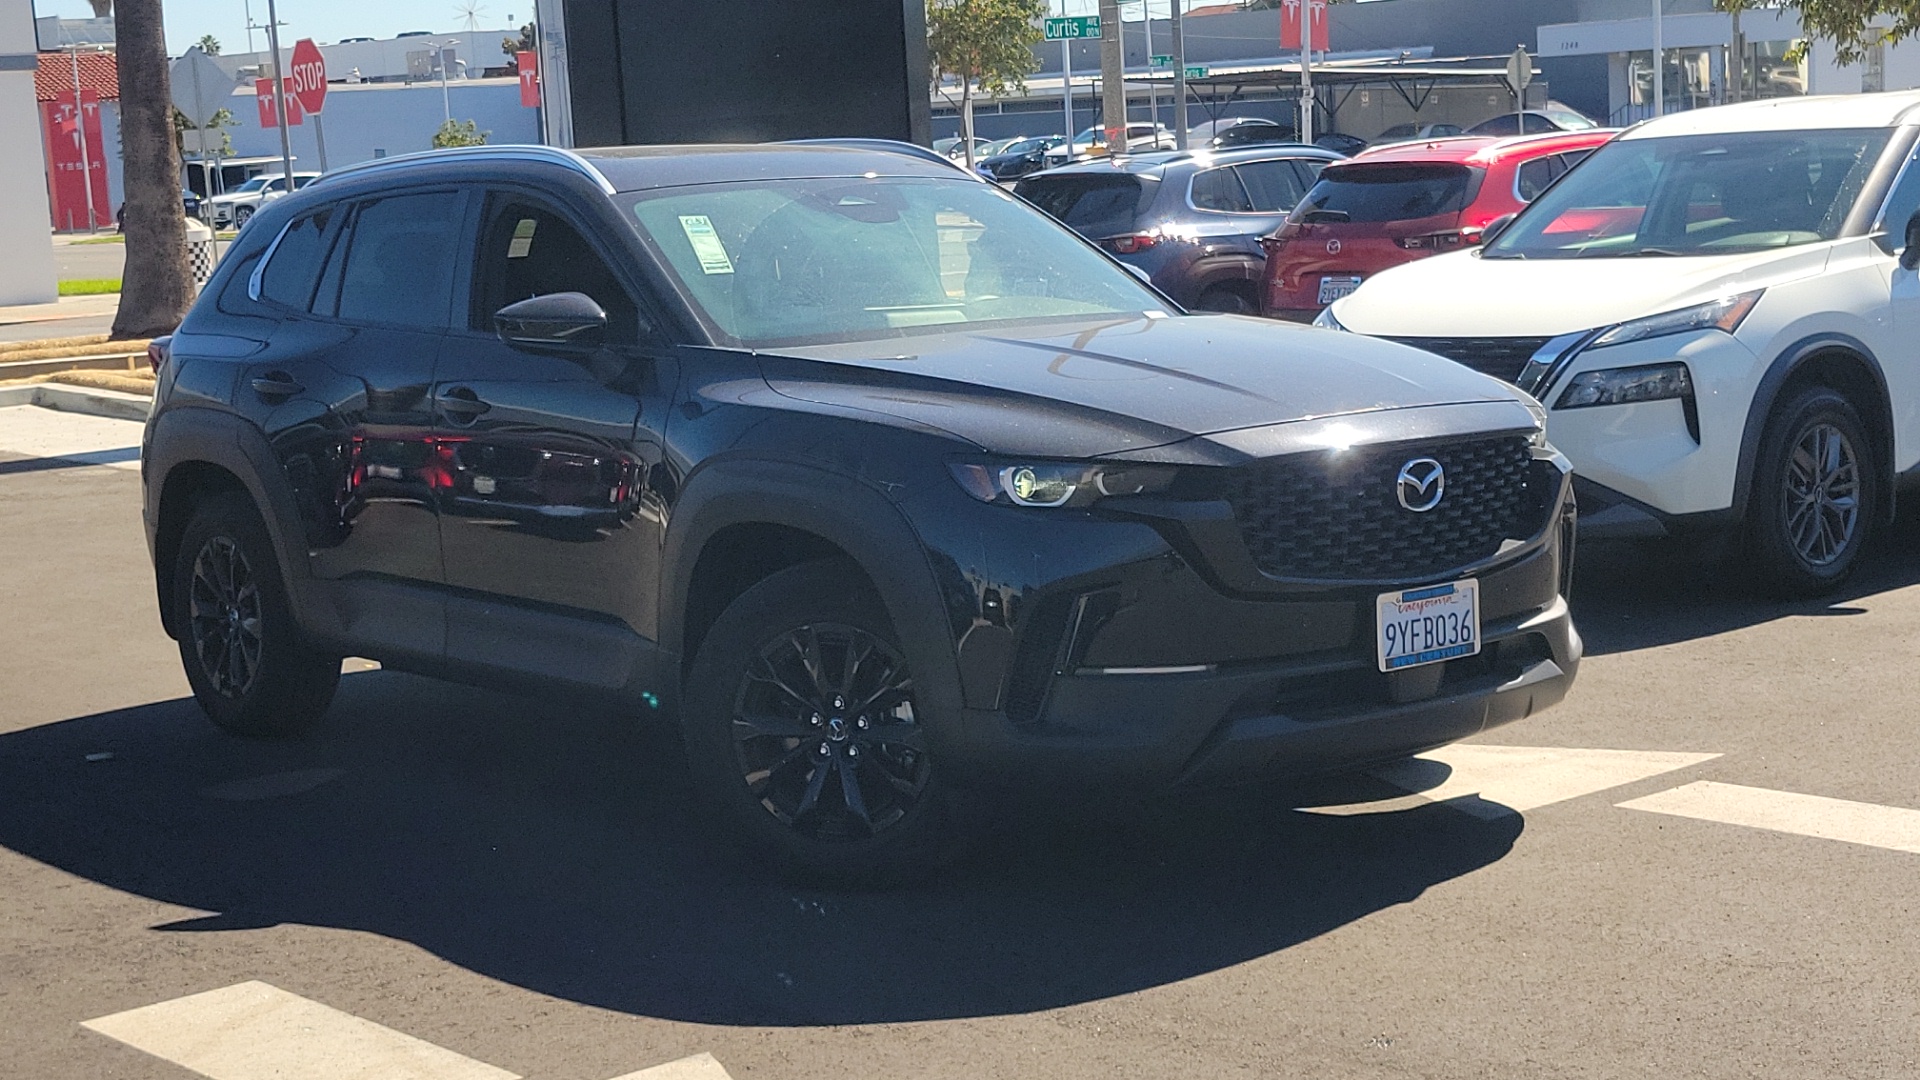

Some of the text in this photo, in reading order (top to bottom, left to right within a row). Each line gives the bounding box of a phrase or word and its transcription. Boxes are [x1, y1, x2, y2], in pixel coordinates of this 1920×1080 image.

[1046, 17, 1098, 38] Curtis AVE
[293, 61, 324, 93] STOP
[1385, 609, 1470, 657] 9YFB036
